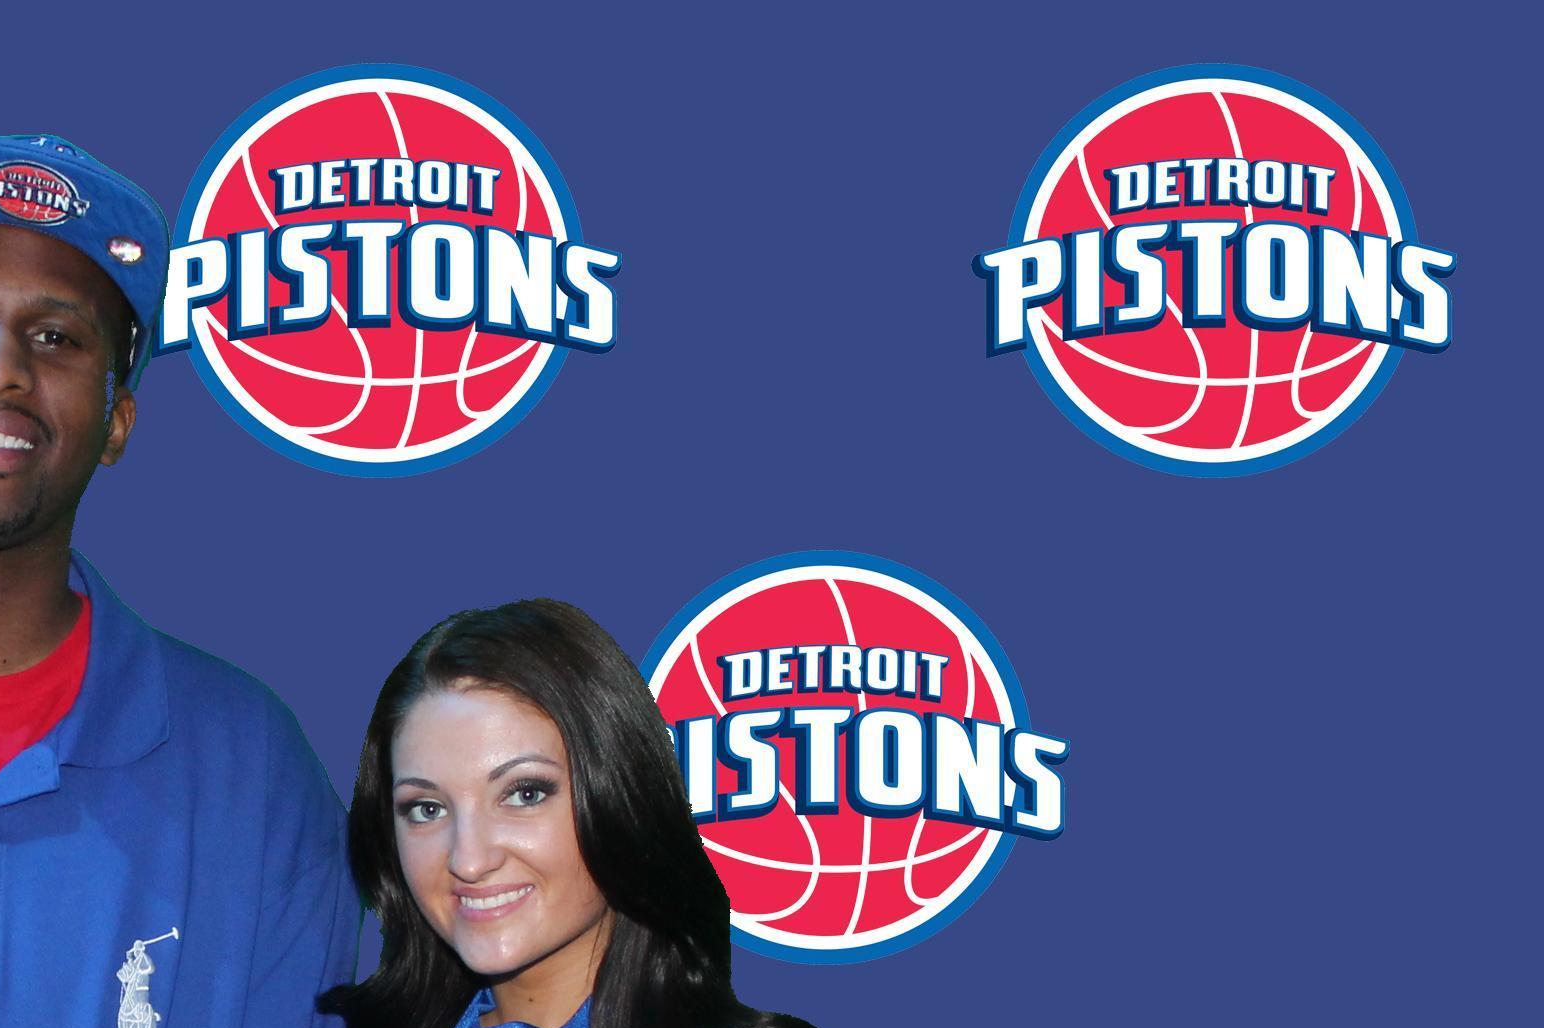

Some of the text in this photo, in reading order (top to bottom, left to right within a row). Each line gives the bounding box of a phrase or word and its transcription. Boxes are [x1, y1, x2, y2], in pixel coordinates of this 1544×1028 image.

[270, 157, 501, 215] DETROIT
[1104, 157, 1337, 215] DETROIT
[154, 219, 623, 358] PISTONS
[971, 219, 1457, 358] PISTONS
[716, 644, 950, 702] DETROIT
[667, 706, 1070, 841] ISTONS
